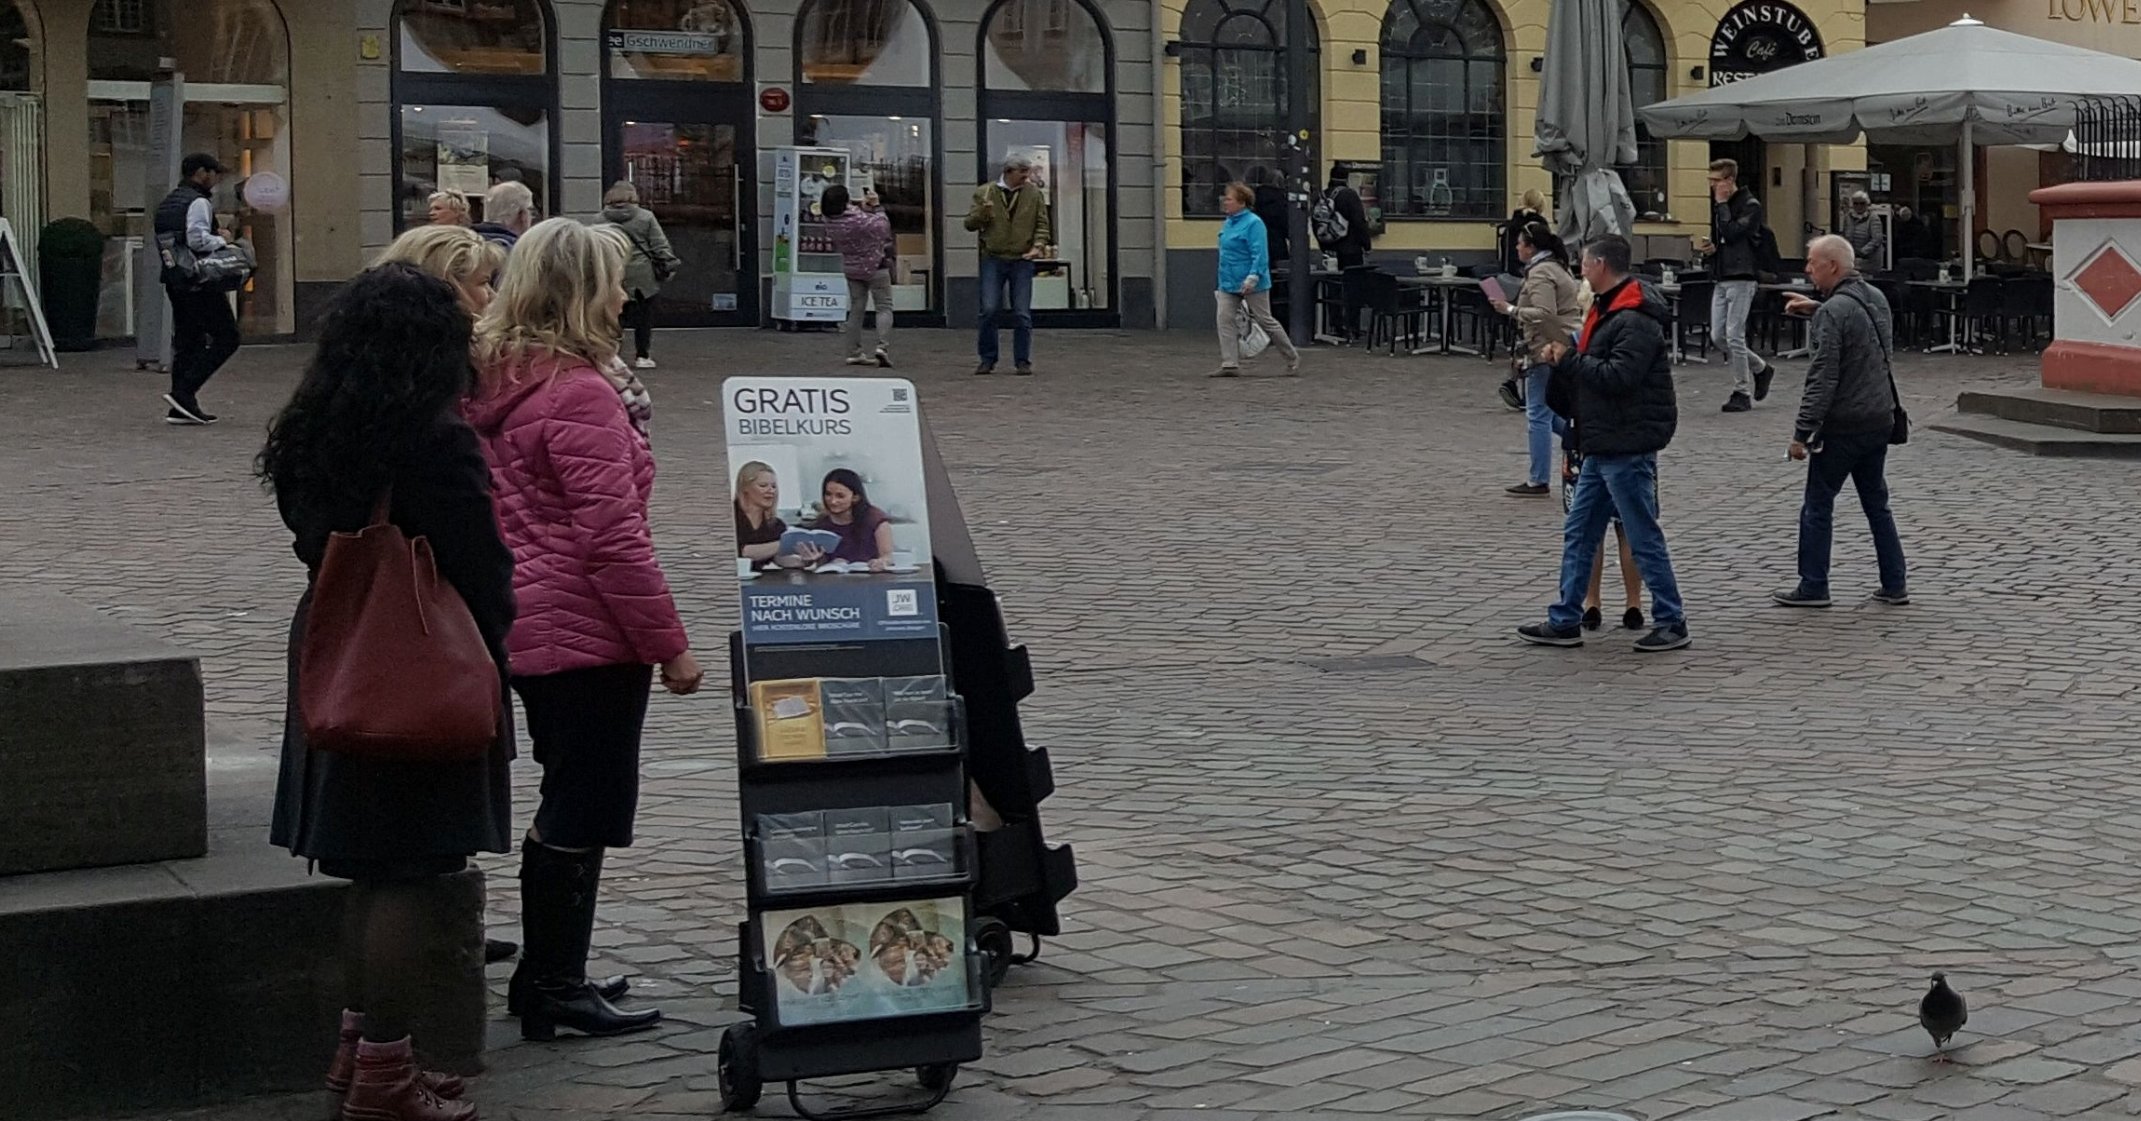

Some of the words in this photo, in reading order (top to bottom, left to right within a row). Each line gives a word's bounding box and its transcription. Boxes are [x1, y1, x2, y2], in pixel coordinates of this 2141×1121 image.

[1713, 5, 1820, 60] WEINSTUBE
[1746, 40, 1778, 61] Café
[801, 296, 817, 307] ICE
[819, 296, 838, 307] TEA
[734, 387, 850, 414] GRATIS
[738, 418, 852, 435] BIBELKURS
[749, 594, 813, 608] TERMINE
[751, 609, 792, 622] NACH
[796, 607, 861, 620] WUNSCH
